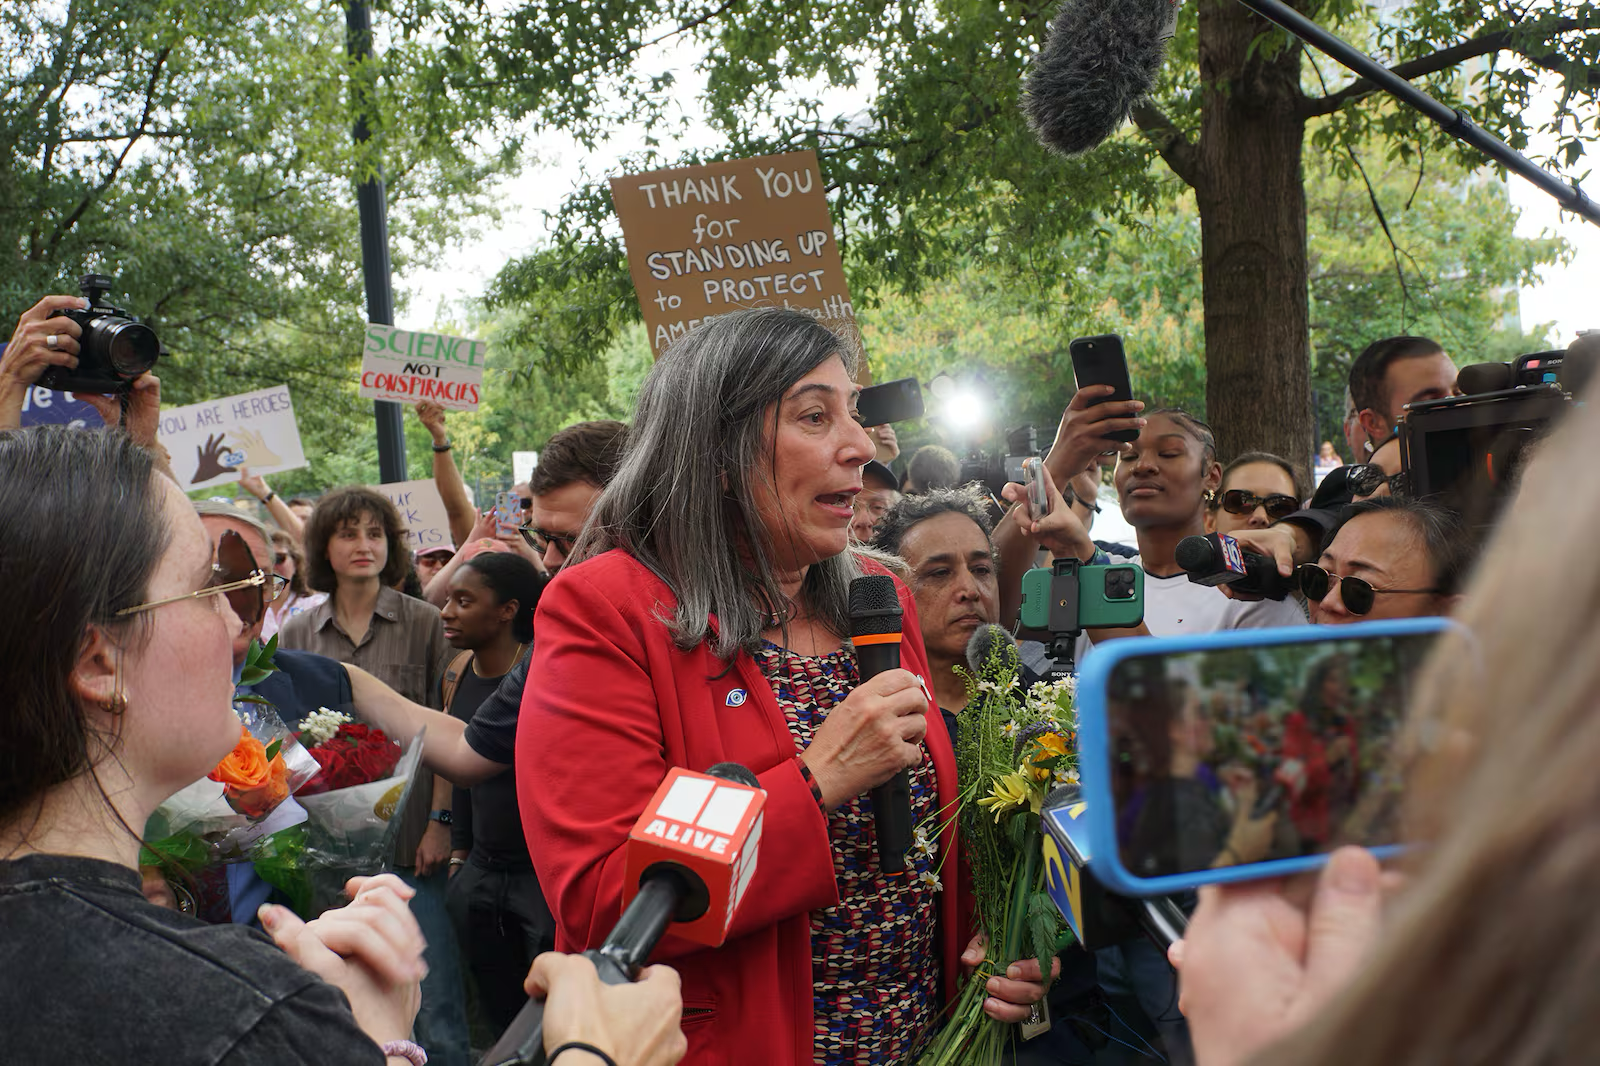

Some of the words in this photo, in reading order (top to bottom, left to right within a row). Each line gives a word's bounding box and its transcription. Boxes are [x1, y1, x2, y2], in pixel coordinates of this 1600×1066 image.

[638, 175, 743, 208] THANK
[755, 167, 813, 198] YOU
[692, 214, 740, 244] for
[646, 239, 791, 280] STANDING
[797, 230, 828, 257] UP
[654, 290, 682, 312] to
[703, 270, 825, 304] PROTECT
[366, 326, 486, 366] SCIENCE
[361, 371, 480, 404] CONSPIRACIES
[402, 362, 447, 378] NOT
[196, 406, 223, 428] ARE
[232, 392, 290, 419] HEROES
[644, 819, 730, 855] ALIVE
